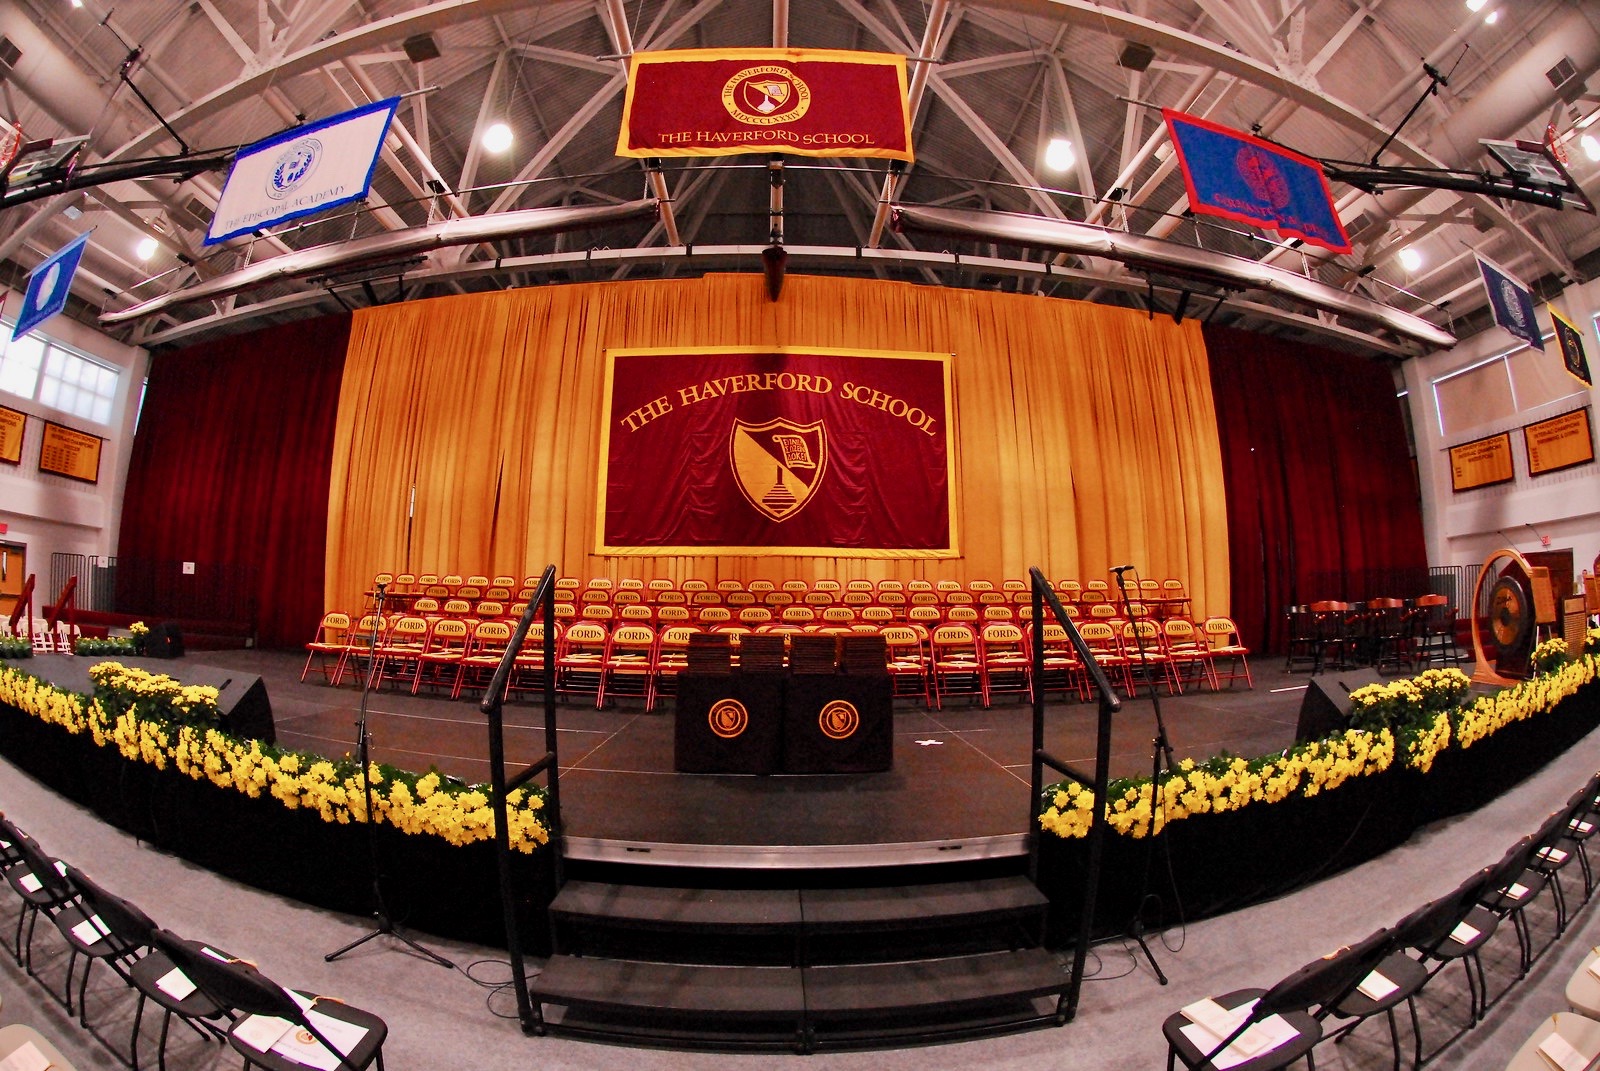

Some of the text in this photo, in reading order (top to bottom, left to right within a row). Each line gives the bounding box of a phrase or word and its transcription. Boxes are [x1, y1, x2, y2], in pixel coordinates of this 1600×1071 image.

[724, 84, 735, 98] THE
[732, 67, 788, 85] HAVERFORD
[658, 130, 875, 145] THE HAVERFORD SCHOOL
[620, 372, 938, 437] THE HAVERFORD SCHOOL
[571, 630, 601, 638] FORDS
[668, 632, 690, 640] FOR
